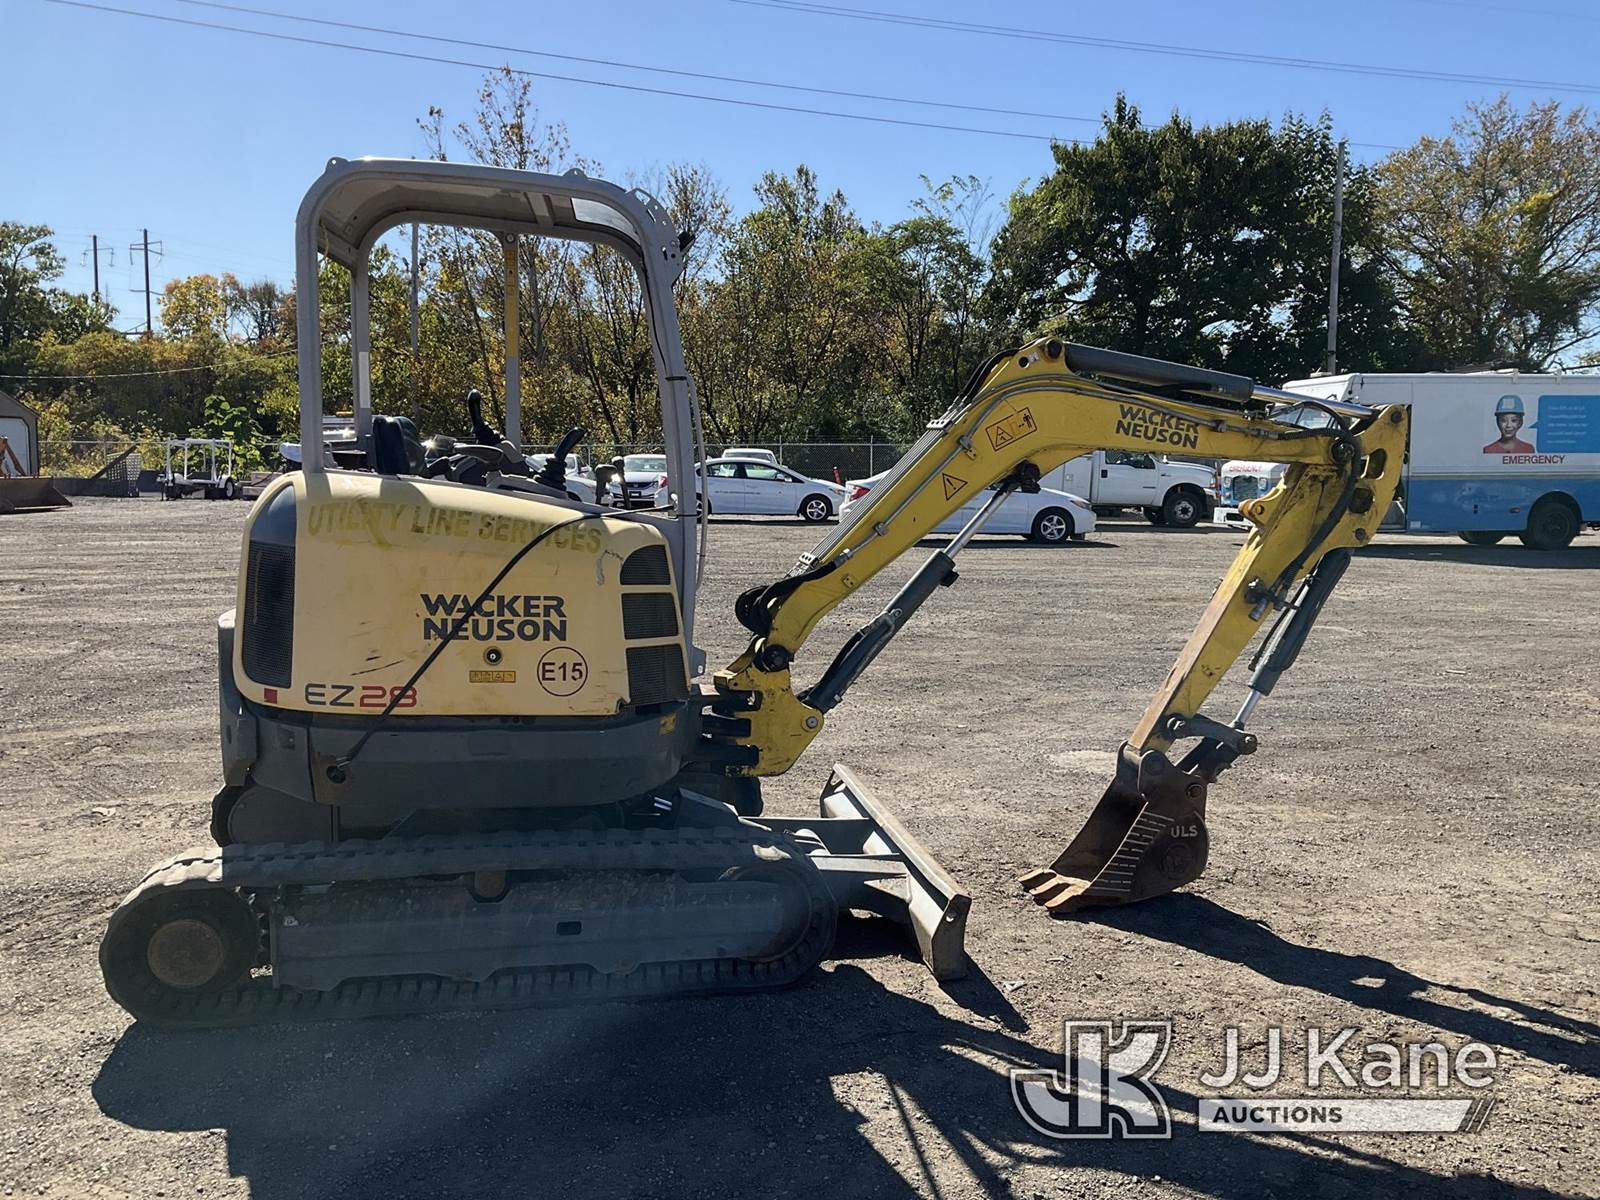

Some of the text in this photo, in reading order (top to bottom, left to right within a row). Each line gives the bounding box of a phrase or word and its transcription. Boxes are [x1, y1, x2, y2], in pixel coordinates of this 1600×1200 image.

[1119, 404, 1199, 434] WACKER
[1115, 420, 1199, 449] NEUSON
[1502, 455, 1566, 465] EMERGENCY
[410, 506, 472, 537] LINE
[420, 593, 567, 617] WACKER
[423, 618, 567, 641] NEUSON
[541, 660, 584, 681] E15
[305, 683, 417, 708] EZ28
[1171, 825, 1198, 838] ULS
